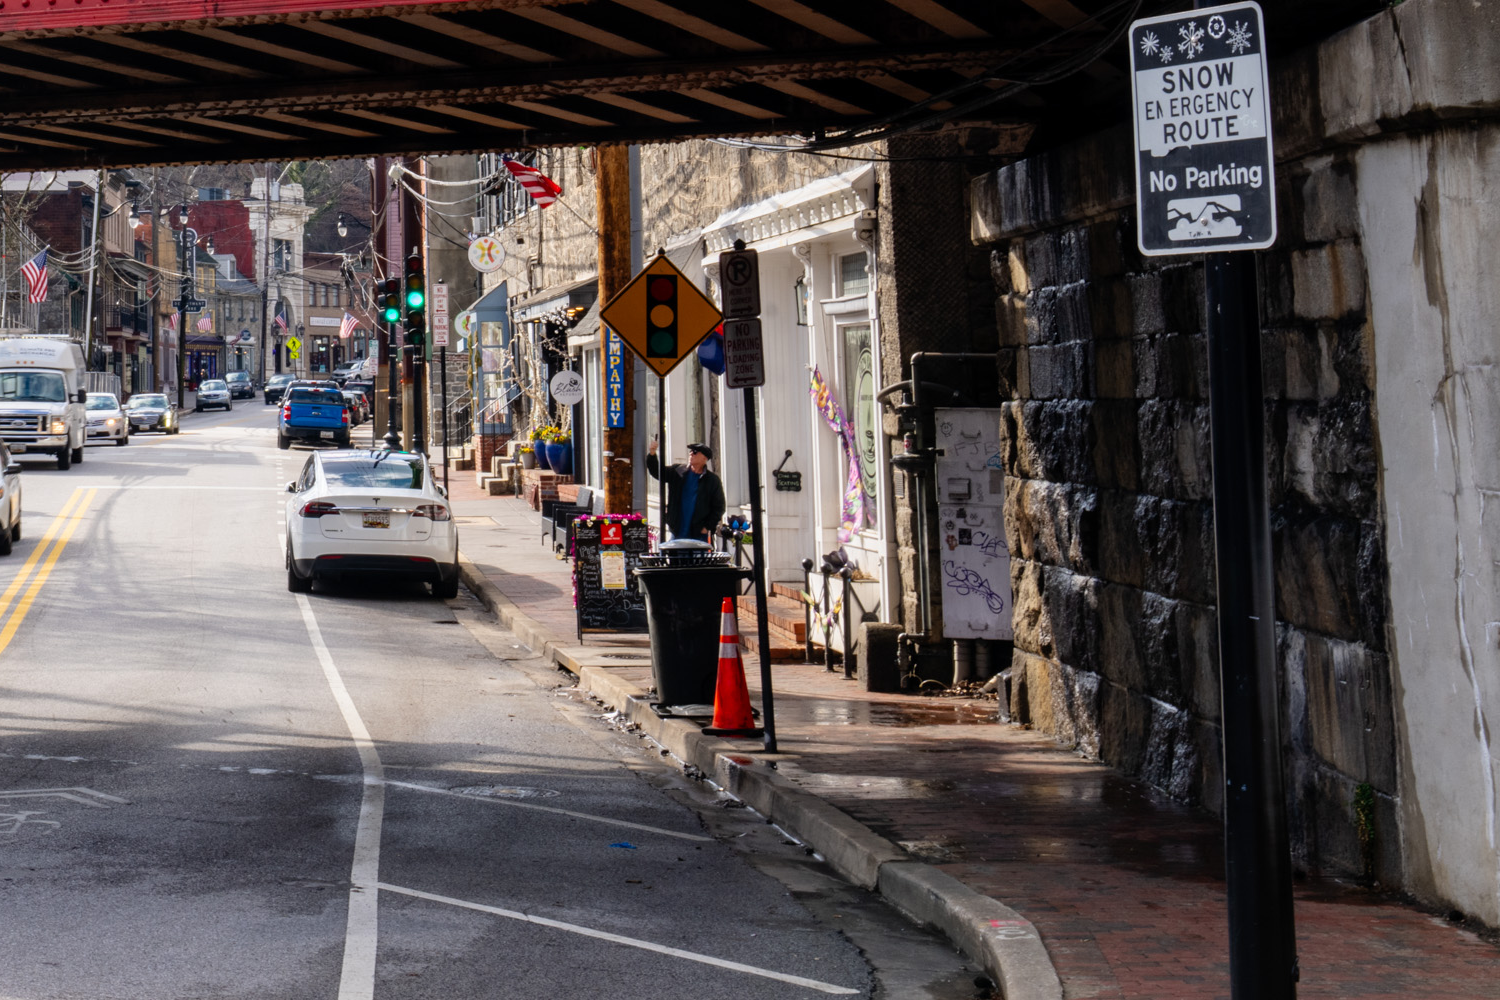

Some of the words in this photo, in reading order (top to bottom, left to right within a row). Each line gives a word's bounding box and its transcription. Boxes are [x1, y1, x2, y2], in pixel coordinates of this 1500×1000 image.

[1161, 61, 1234, 94] SNOW
[1163, 115, 1239, 144] ROUTE
[1150, 170, 1177, 193] No
[1185, 163, 1263, 190] Parking
[735, 323, 750, 337] NO
[727, 337, 760, 353] PARKING
[728, 352, 760, 365] LOADING
[735, 364, 755, 375] ZONE
[608, 329, 621, 426] EMPATHY
